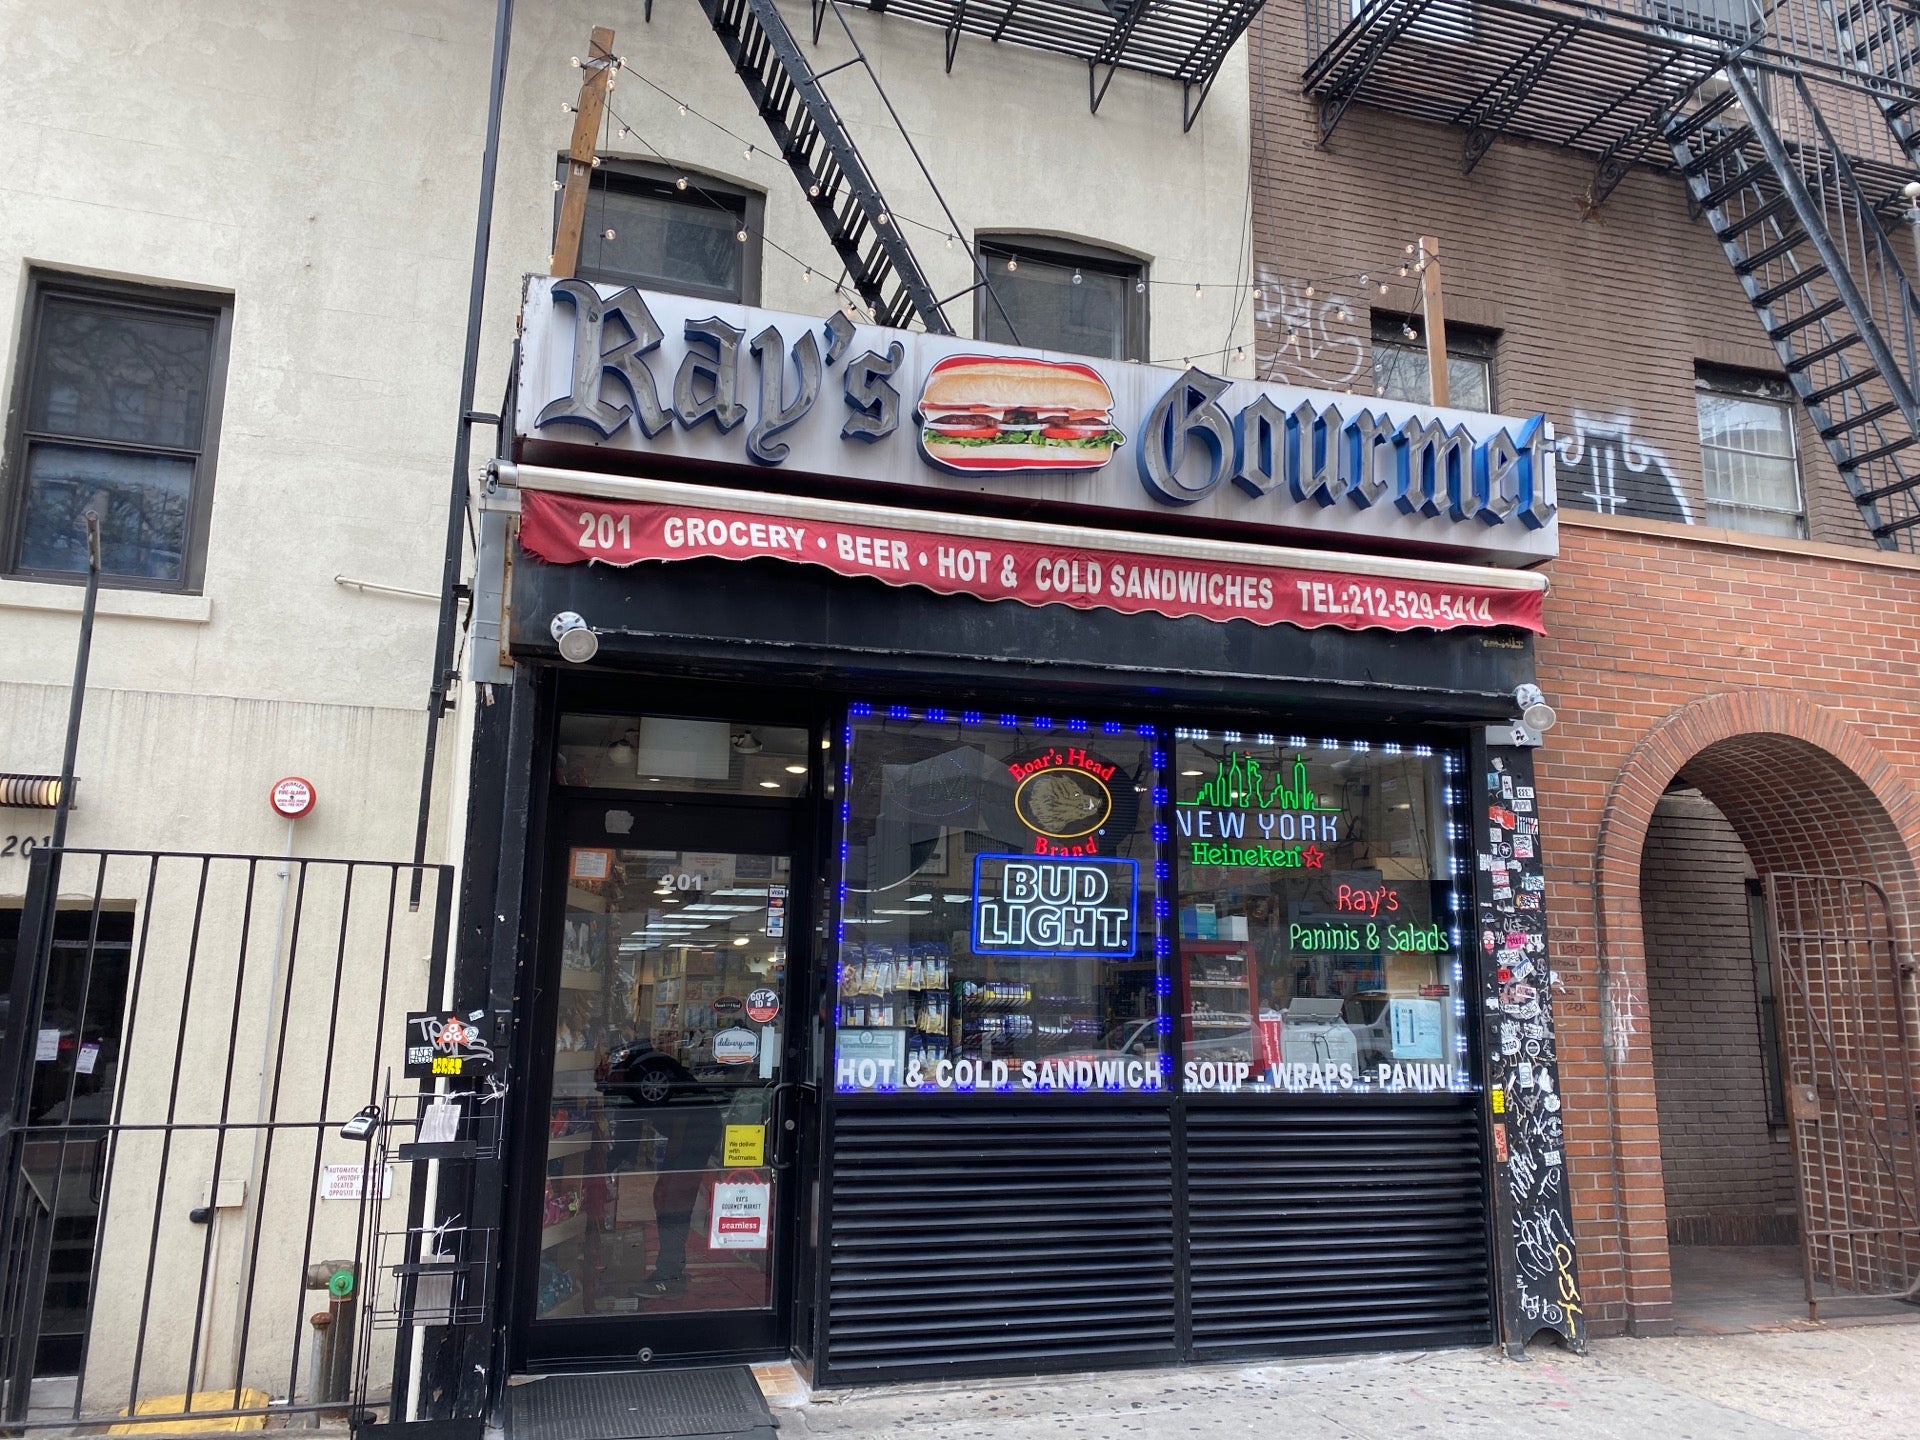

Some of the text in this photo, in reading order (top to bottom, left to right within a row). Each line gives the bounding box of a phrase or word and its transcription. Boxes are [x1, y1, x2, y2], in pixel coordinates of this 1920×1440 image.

[534, 278, 904, 467] Ray's
[1136, 366, 1558, 530] Gourmet
[579, 512, 1494, 623] 201 GROCERY BEER HOT & COLD SANDWICHES TEL:212-529-5414
[1008, 748, 1116, 784] Boar's Head
[1176, 810, 1338, 842] NEW YORK
[1034, 836, 1098, 858] Brand
[1191, 842, 1302, 868] Heineken
[661, 873, 702, 891] 201
[771, 888, 785, 896] VISA
[1003, 863, 1109, 906] BUD
[1337, 883, 1399, 917] Ray's
[1289, 922, 1450, 953] Paninis & Salads
[750, 992, 766, 1002] GOT
[717, 1037, 755, 1050] delivery.com
[836, 1058, 1162, 1090] HOT & COLD SANDWICH
[1184, 1062, 1454, 1090] SOUP WRAPS PANINI
[721, 1222, 758, 1230] seamless
